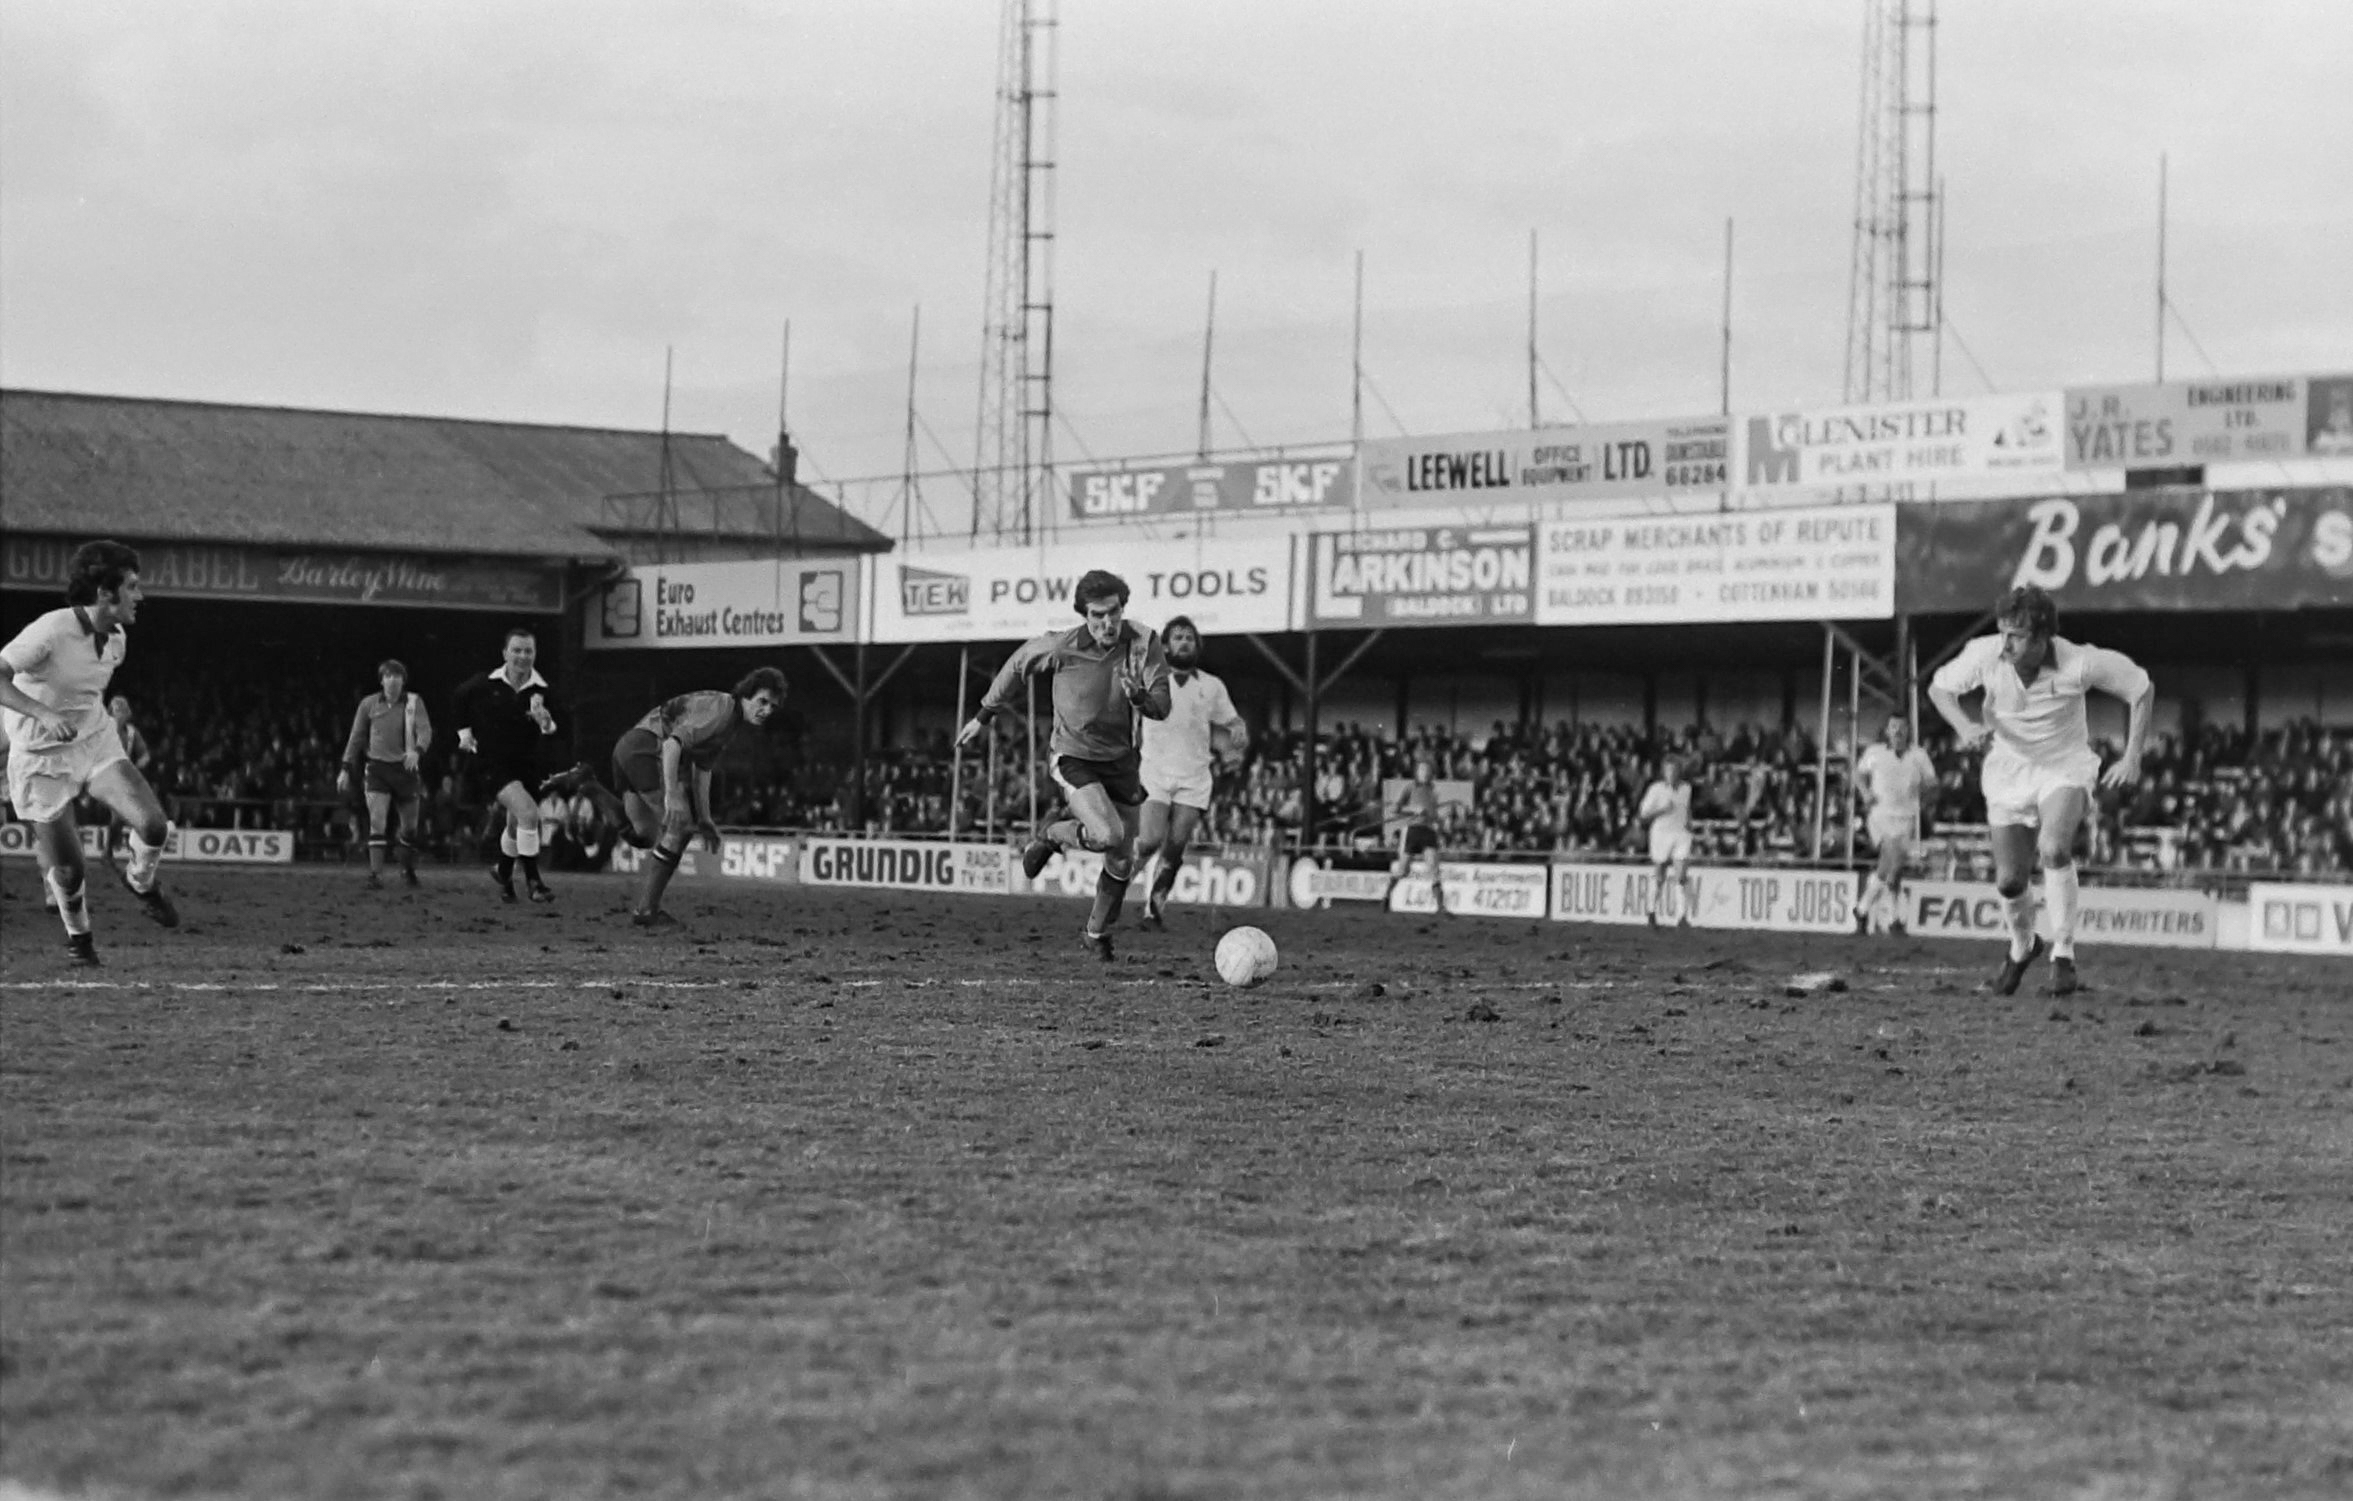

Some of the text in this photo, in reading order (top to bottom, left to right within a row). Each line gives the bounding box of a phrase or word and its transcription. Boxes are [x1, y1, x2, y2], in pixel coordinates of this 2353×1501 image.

[2071, 419, 2174, 462] YATES
[1254, 463, 1340, 504] SKF
[1407, 449, 1511, 492] LEEWELL
[1085, 472, 1165, 513] SKF
[1550, 528, 1613, 553] SCRAP
[1624, 522, 1747, 549] MERCHANTS
[1797, 516, 1882, 542] REPUTE
[7, 541, 73, 580] GOL
[656, 577, 695, 606] Euro
[990, 568, 1268, 604] POW TOOLS
[656, 606, 785, 637] Exhaust Centres
[198, 833, 281, 856] OATS
[721, 842, 791, 878] SKF
[813, 845, 955, 885] GRUNDIG
[1173, 856, 1256, 904] cho
[1560, 872, 1610, 915] BLUE
[1739, 877, 1779, 920] TOP
[1788, 879, 1849, 925] JOBS
